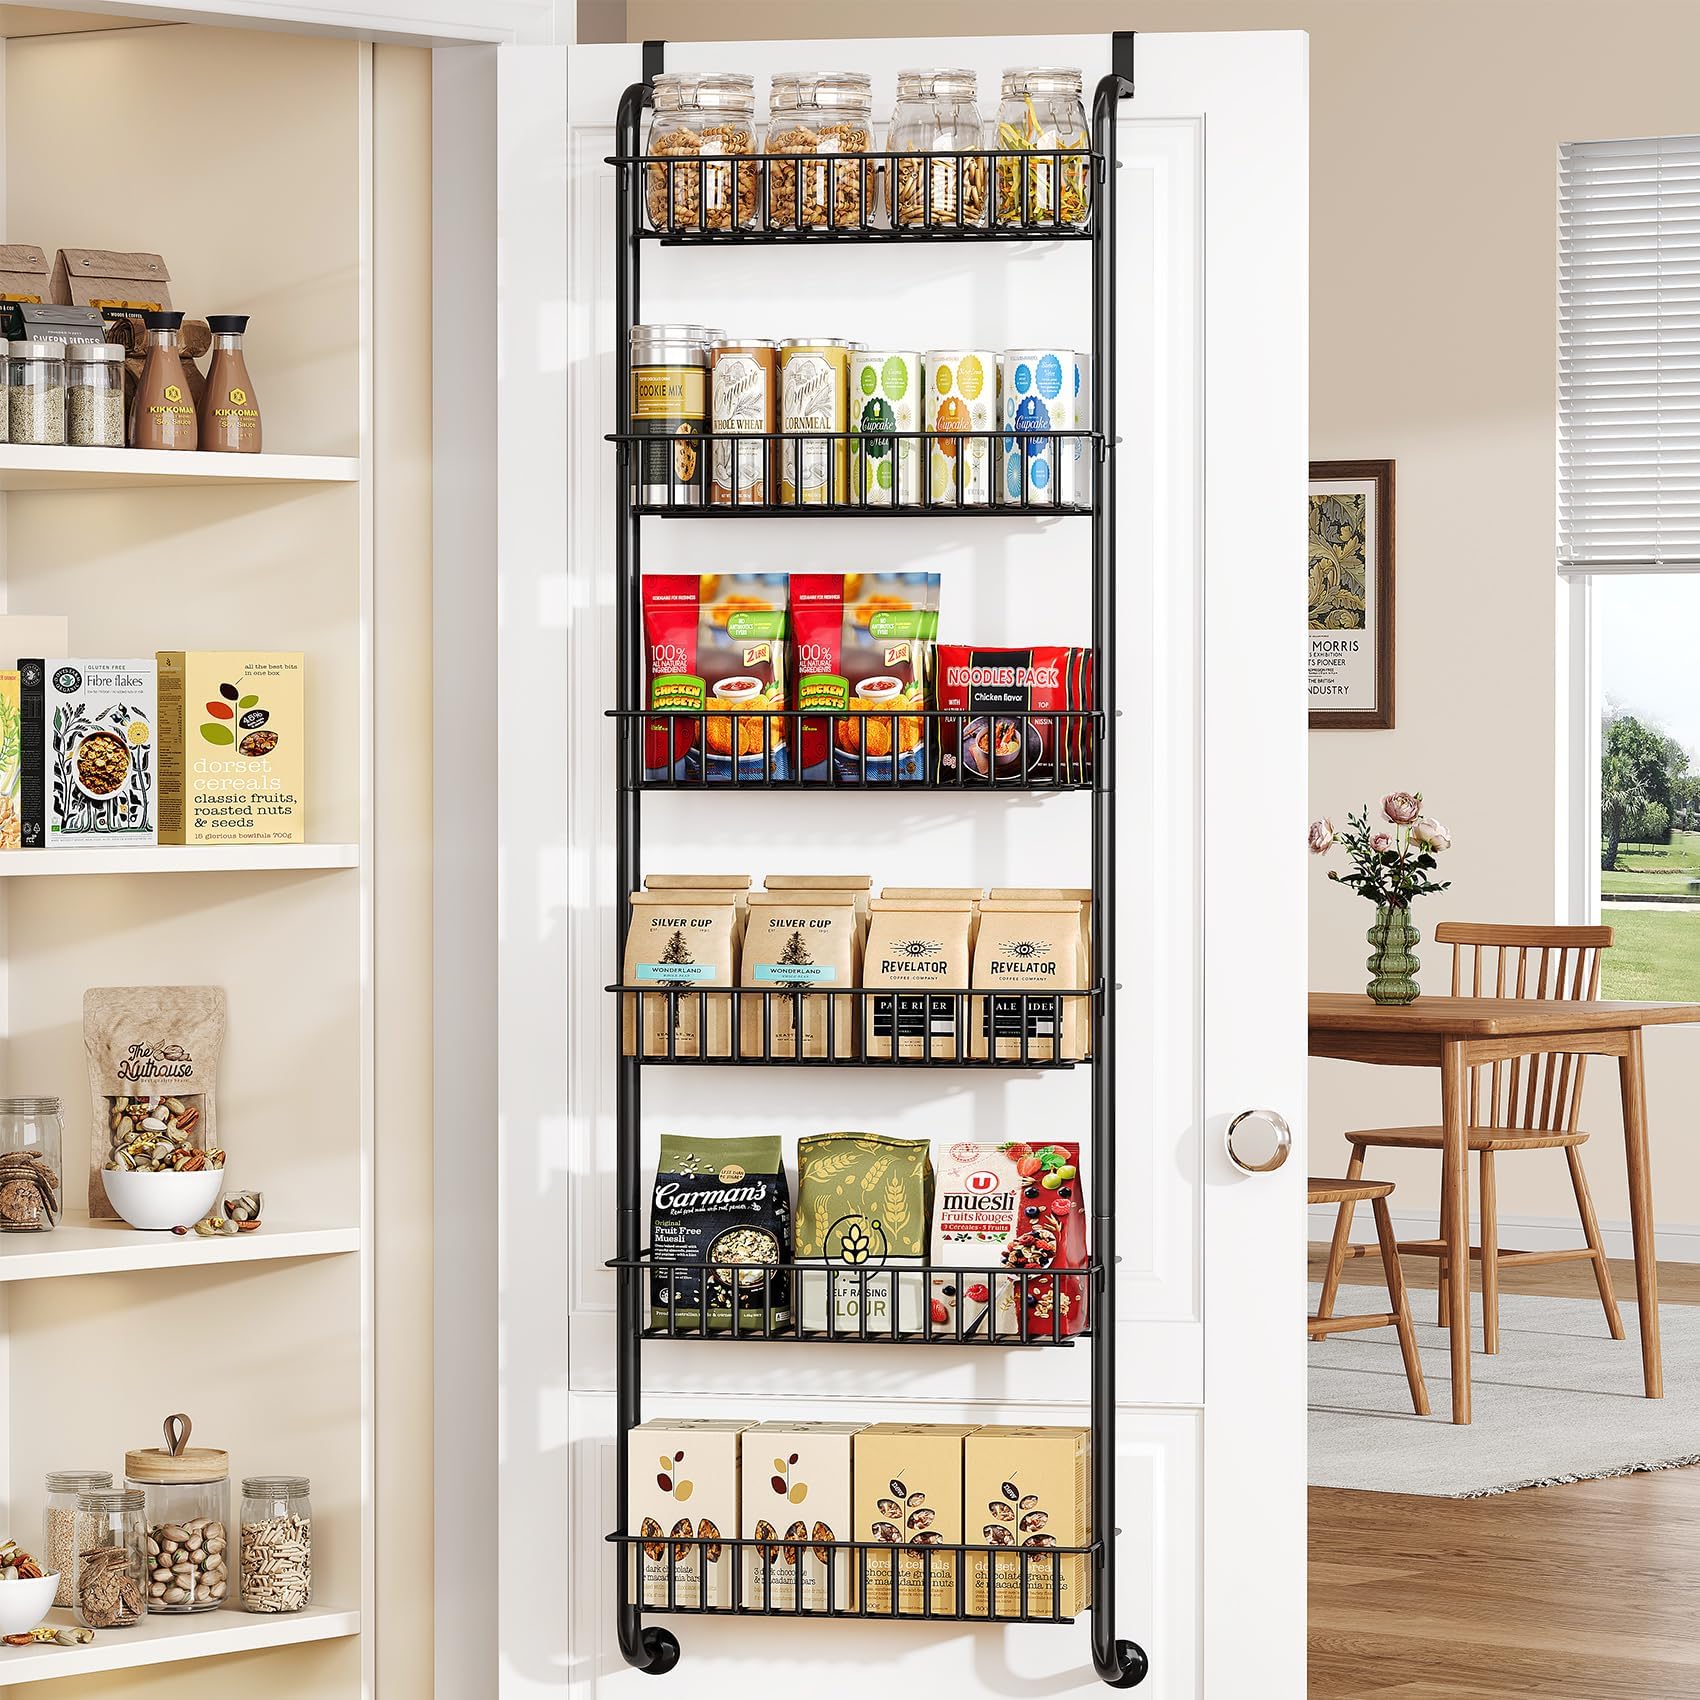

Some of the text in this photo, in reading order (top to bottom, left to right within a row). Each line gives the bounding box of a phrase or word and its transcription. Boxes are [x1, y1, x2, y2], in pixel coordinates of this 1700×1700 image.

[640, 384, 682, 396] COOKIE MIX
[714, 369, 758, 414] Organic
[784, 369, 828, 415] Organic
[150, 406, 194, 414] KIKKOMAN
[215, 408, 258, 417] KIKKOMAN
[714, 420, 763, 430] WHOLE WHEAT
[784, 417, 831, 430] CORNMEAL
[862, 416, 894, 432] Cupcake
[938, 416, 970, 432] Cupcake
[1016, 415, 1048, 429] Cupcake
[651, 644, 688, 660] 100%
[798, 644, 832, 660] 100%
[1312, 640, 1359, 652] MORRIS
[746, 650, 755, 662] 2
[888, 650, 895, 662] 2
[87, 674, 143, 687] Fibre flakes
[948, 666, 1059, 687] NOODLES PACK
[655, 684, 701, 696] CHICKEN
[801, 684, 844, 696] CHICKEN
[654, 696, 701, 709] NUGGETS
[800, 696, 844, 709] NUGGETS
[974, 693, 1023, 702] Chicken flavor
[194, 758, 272, 773] dorset
[194, 775, 281, 790] cereals
[194, 793, 298, 804] classic fruits,
[194, 806, 292, 816] roasted nuts
[194, 818, 254, 828] & seeds
[651, 919, 712, 928] SILVER CUP
[770, 919, 832, 928] SILVER CUP
[882, 960, 948, 974] REVELATOR
[991, 962, 1056, 975] REVELATOR
[128, 1042, 154, 1060] The
[118, 1058, 193, 1082] Nuthouse
[973, 1178, 991, 1189] U
[656, 1181, 767, 1210] Carman's
[943, 1190, 1016, 1211] muesli
[941, 1212, 1013, 1223] Fruits Rouges
[829, 1289, 887, 1297] ELF RASING
[831, 1300, 886, 1316] LOR
[912, 1570, 952, 1579] grnola
